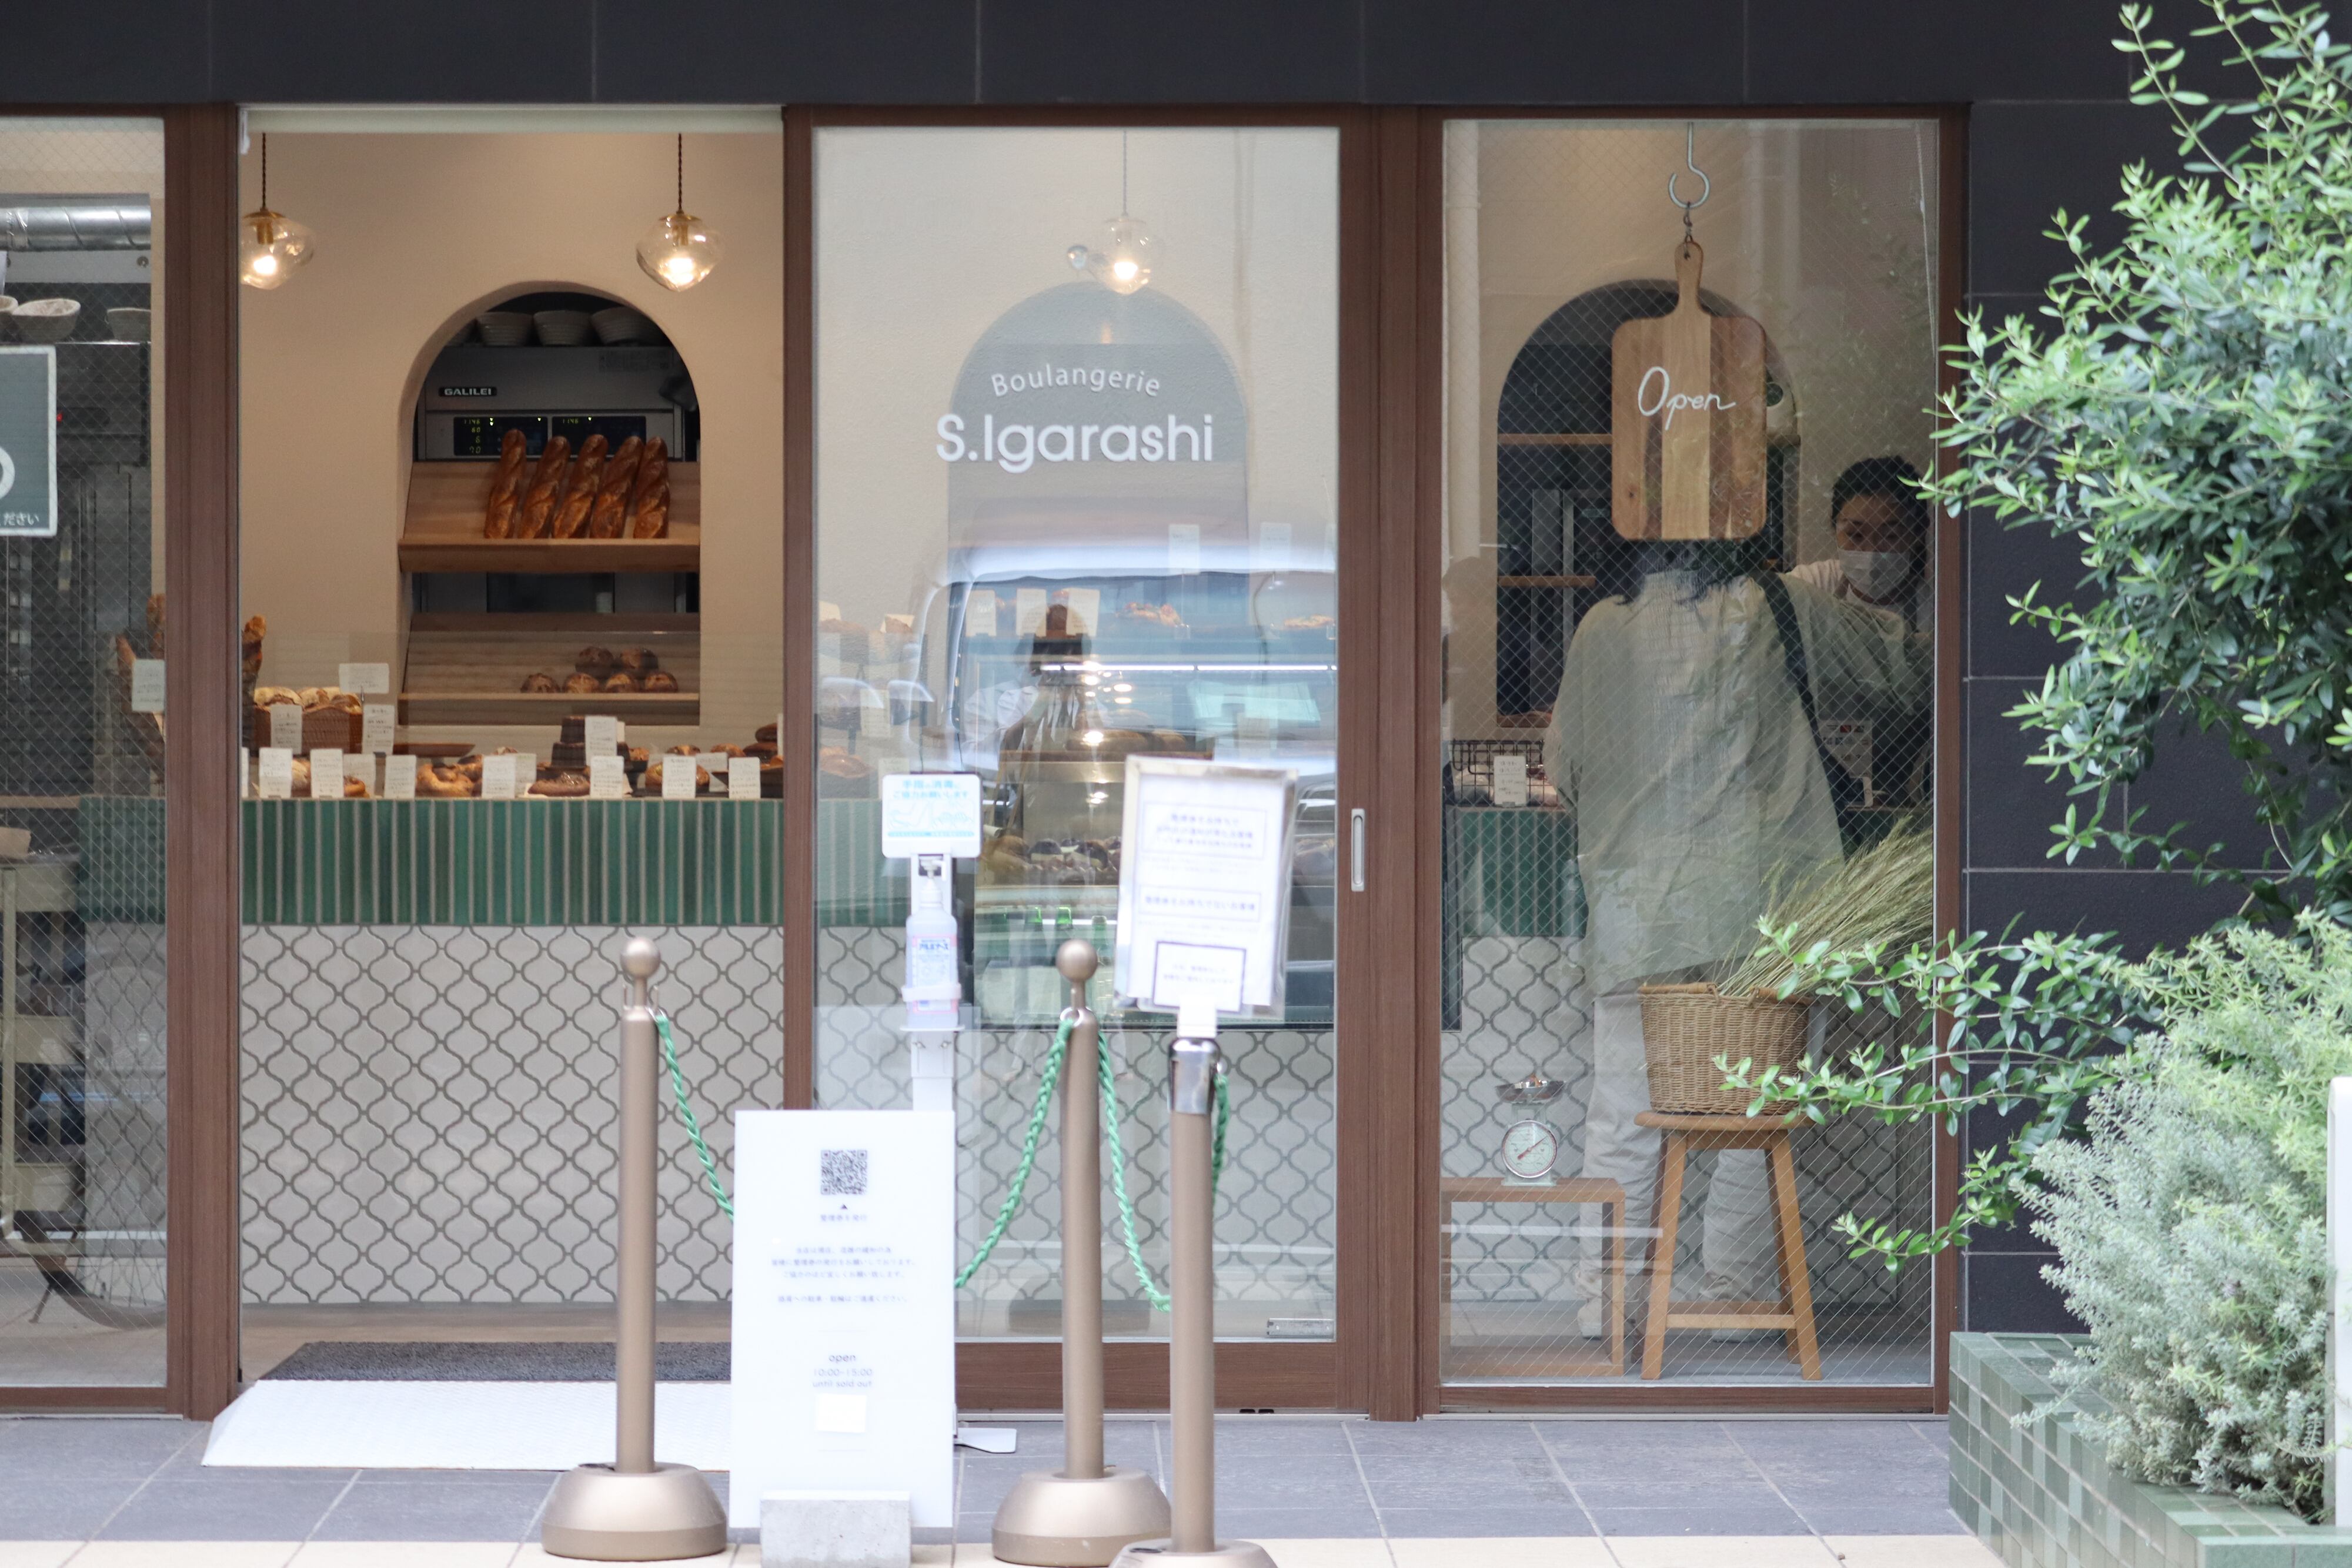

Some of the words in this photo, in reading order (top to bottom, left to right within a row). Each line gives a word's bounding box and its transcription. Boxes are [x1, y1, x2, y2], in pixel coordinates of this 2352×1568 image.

[991, 363, 1161, 397] Boulangerie
[444, 388, 492, 396] GALILEI
[1637, 366, 1736, 431] Open
[936, 413, 1214, 474] S.Igarashi
[0, 511, 39, 526] ださい
[828, 1354, 857, 1363] open
[812, 1379, 833, 1388] until
[836, 1379, 854, 1388] sold
